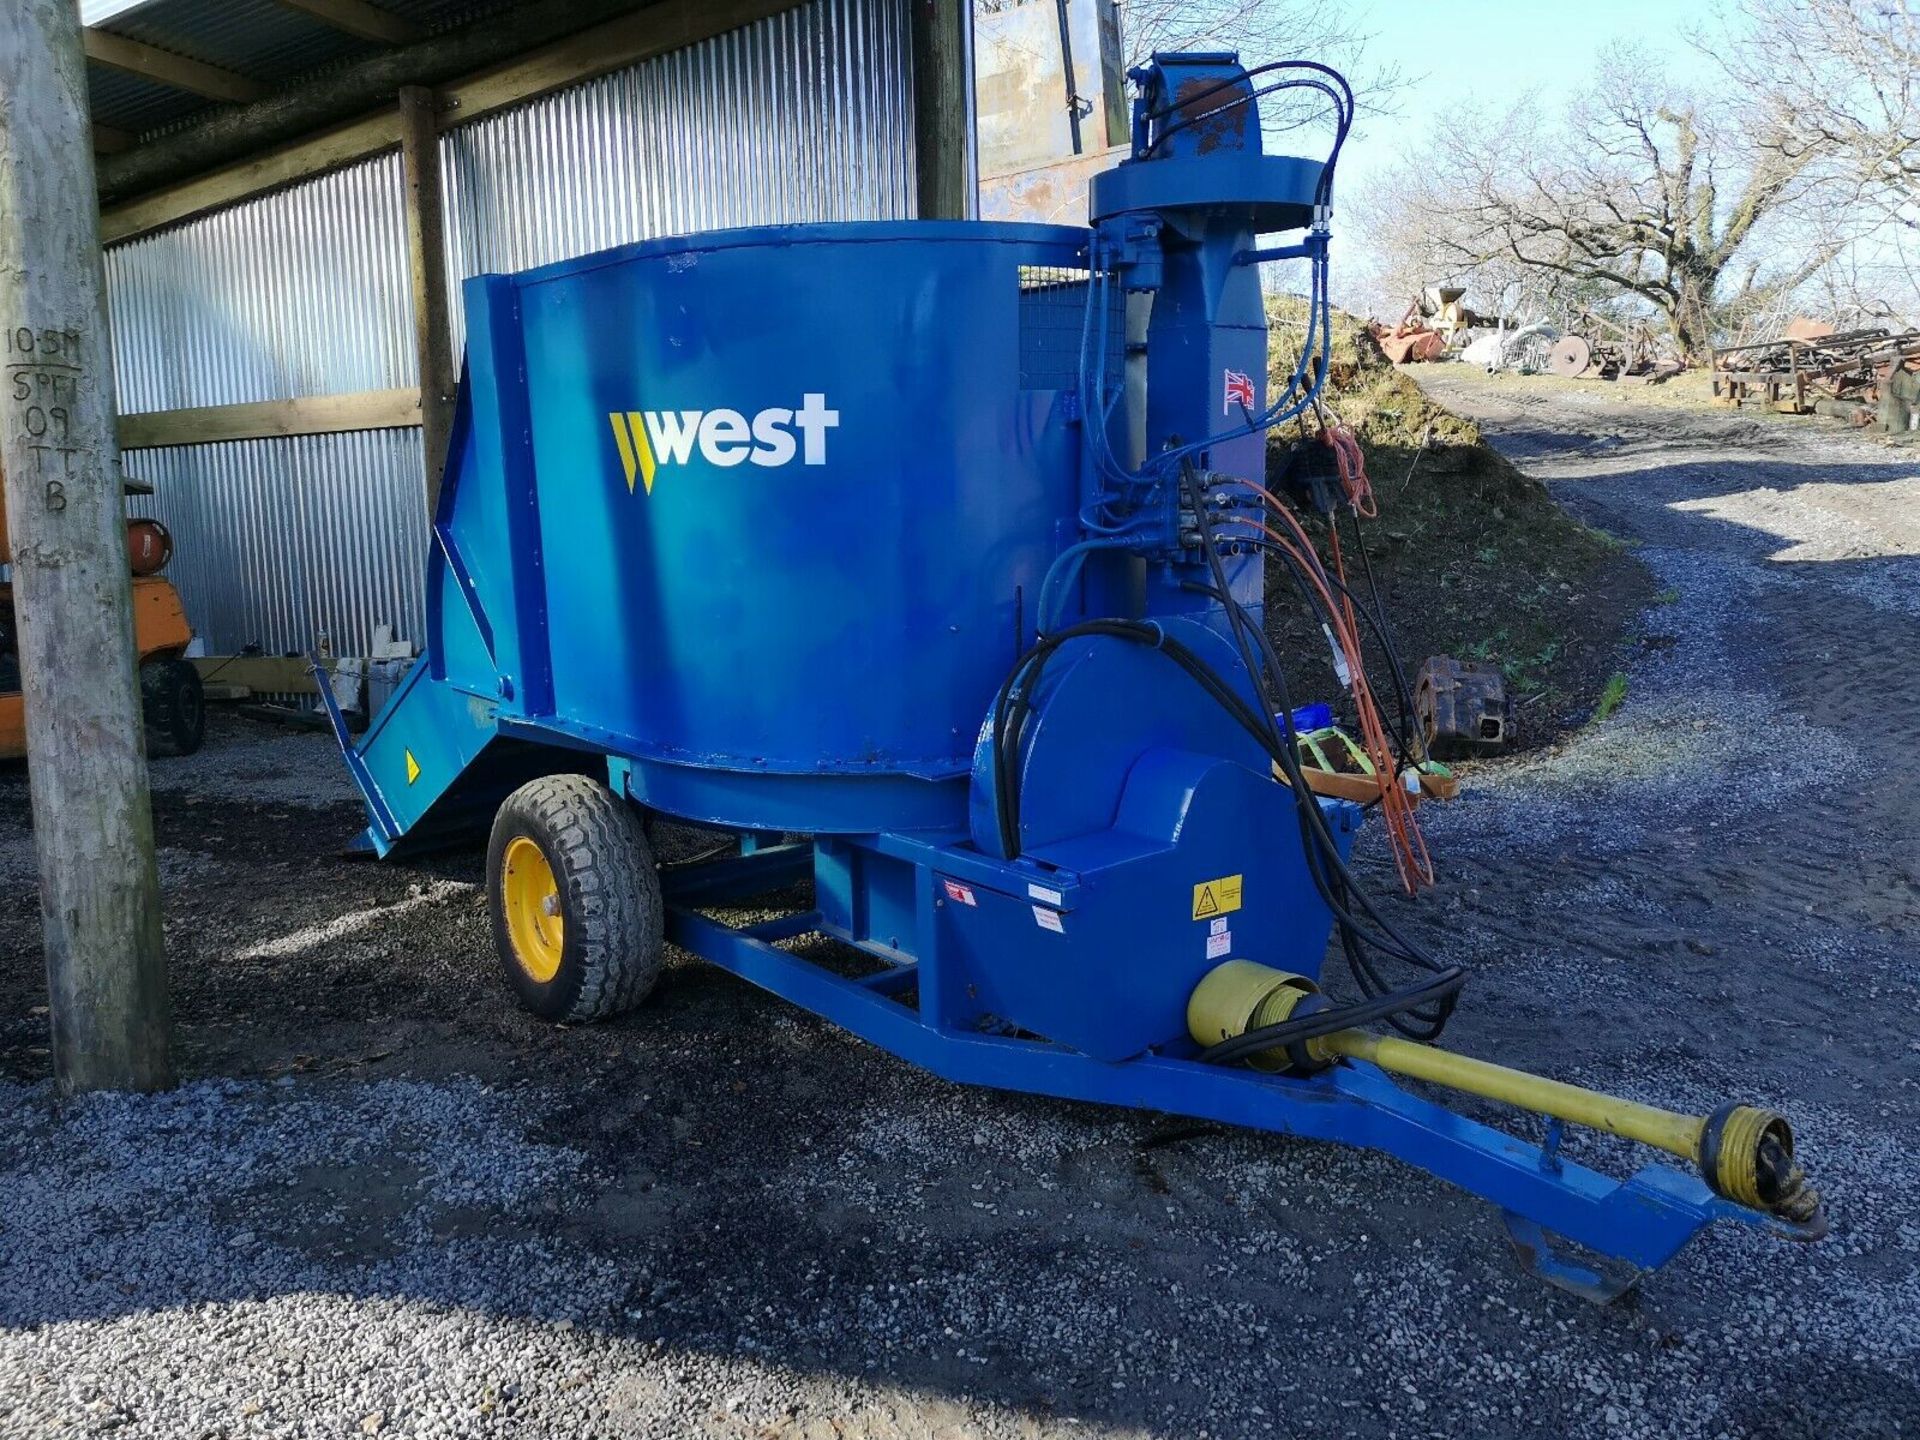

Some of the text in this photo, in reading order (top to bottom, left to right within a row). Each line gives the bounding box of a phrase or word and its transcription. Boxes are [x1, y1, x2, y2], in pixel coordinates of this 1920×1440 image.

[26, 405, 69, 440] 09
[643, 392, 840, 468] west
[45, 480, 68, 511] B
